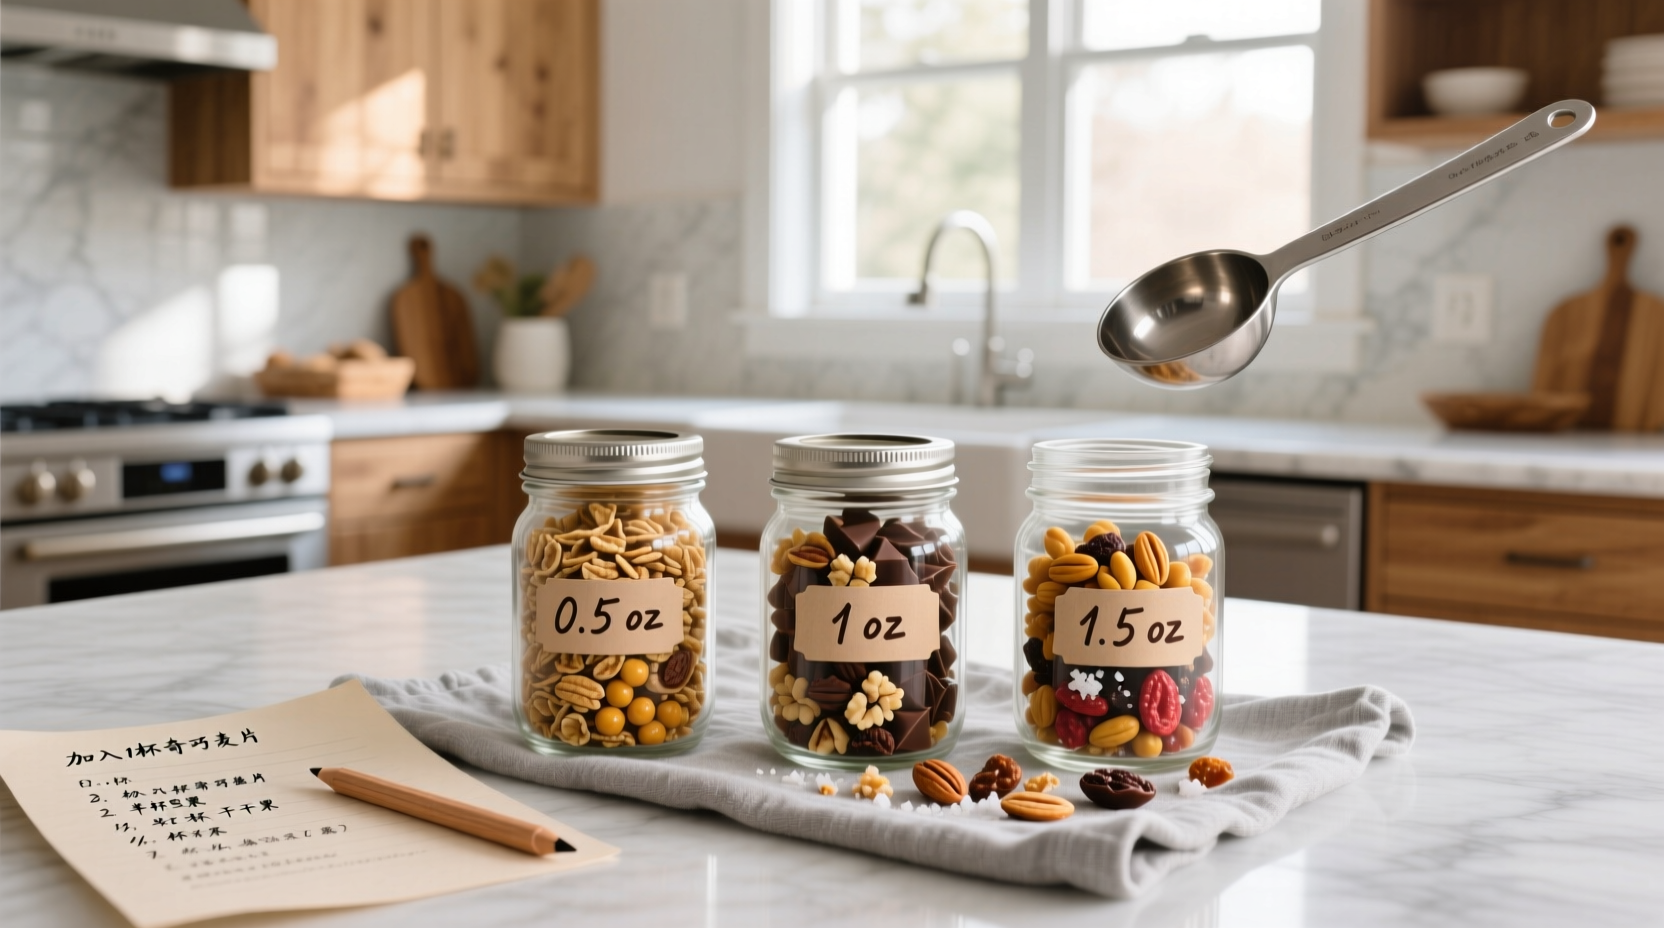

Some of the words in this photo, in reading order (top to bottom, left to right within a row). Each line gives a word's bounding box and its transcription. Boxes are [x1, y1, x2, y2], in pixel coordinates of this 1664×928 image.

[554, 595, 621, 635] 0.5
[625, 608, 664, 632] oz
[831, 602, 852, 646] 1
[863, 615, 906, 640] oz
[1079, 604, 1145, 647] 1.5
[1147, 620, 1185, 644] oz
[66, 728, 259, 767] 加入1杯奇巧麦片
